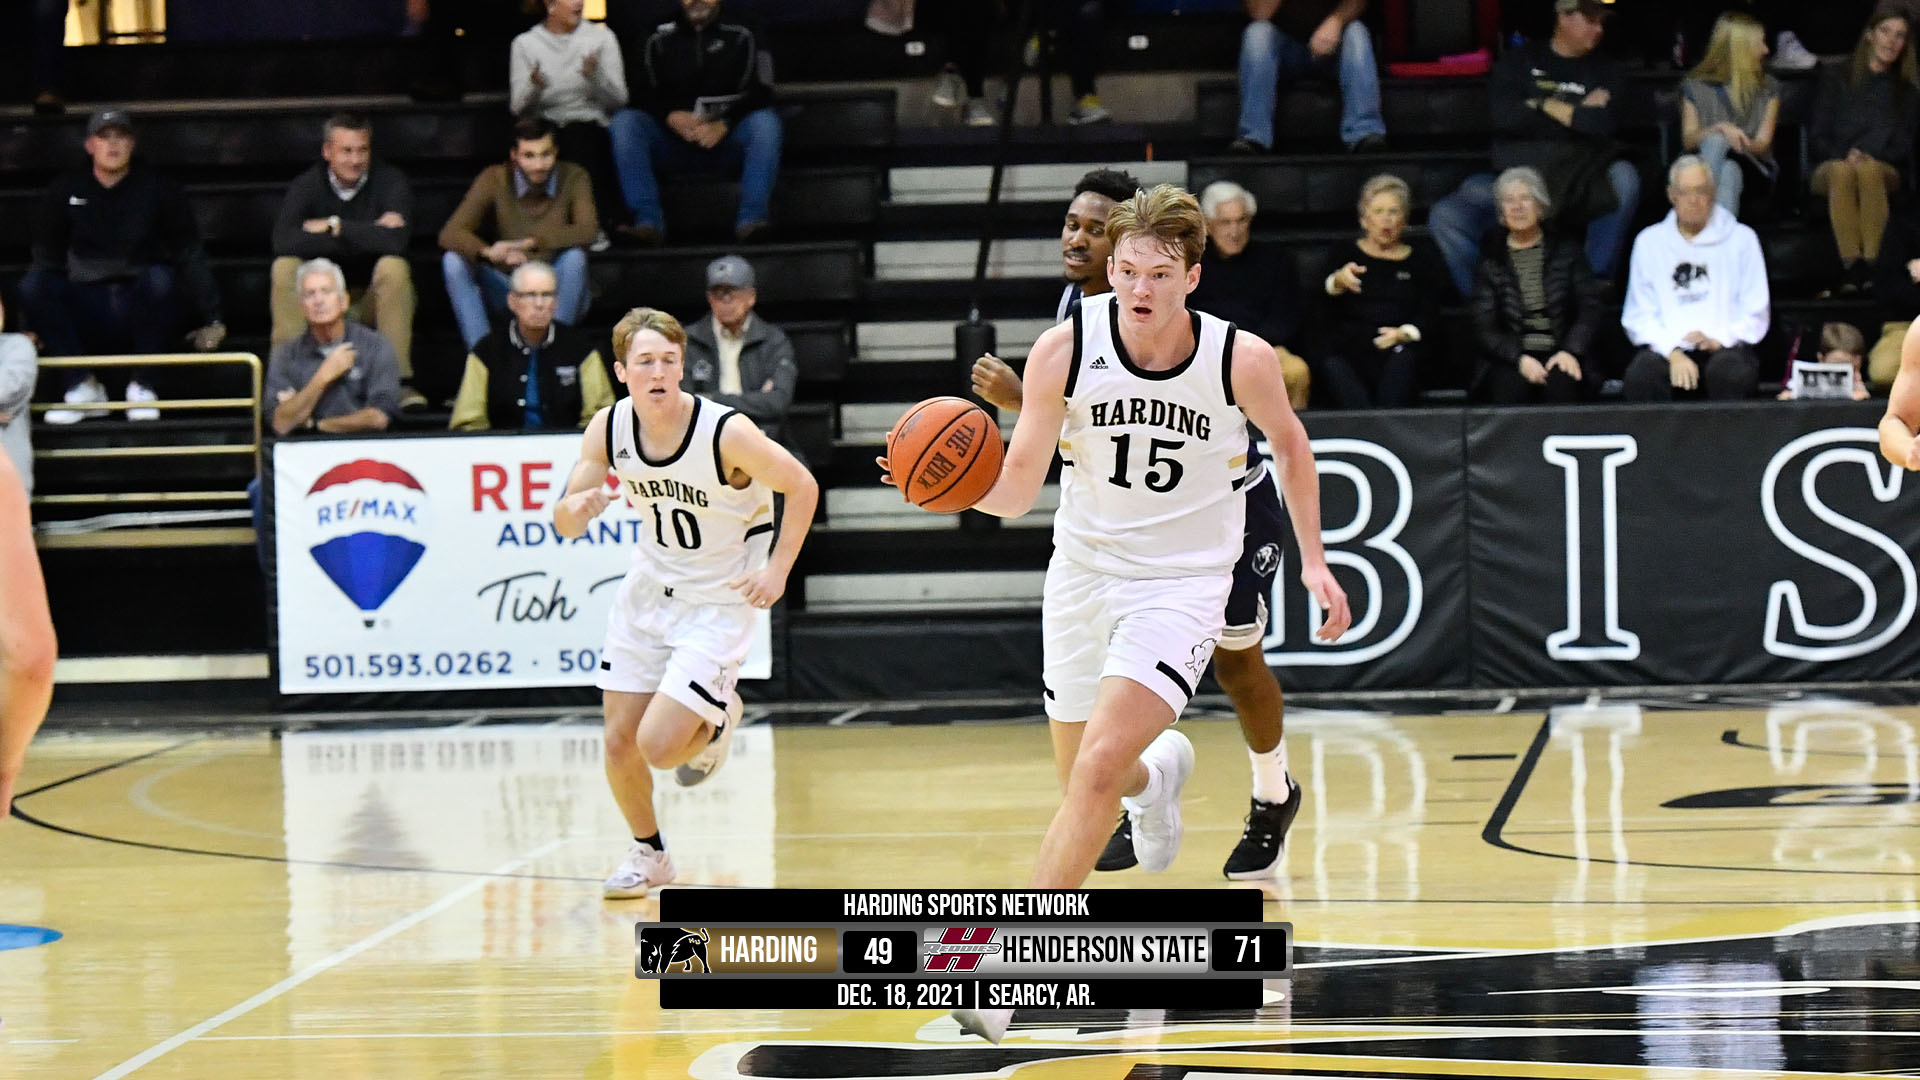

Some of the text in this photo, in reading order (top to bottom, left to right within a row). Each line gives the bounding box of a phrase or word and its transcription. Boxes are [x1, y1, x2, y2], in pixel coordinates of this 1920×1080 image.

[1091, 398, 1211, 441] HARDING
[917, 424, 976, 489] THE ROCK
[1108, 433, 1185, 493] 15
[317, 499, 417, 526] RE/MAX
[650, 502, 702, 550] 10
[477, 571, 578, 622] Tish
[305, 648, 603, 679] 501.593.0262 50
